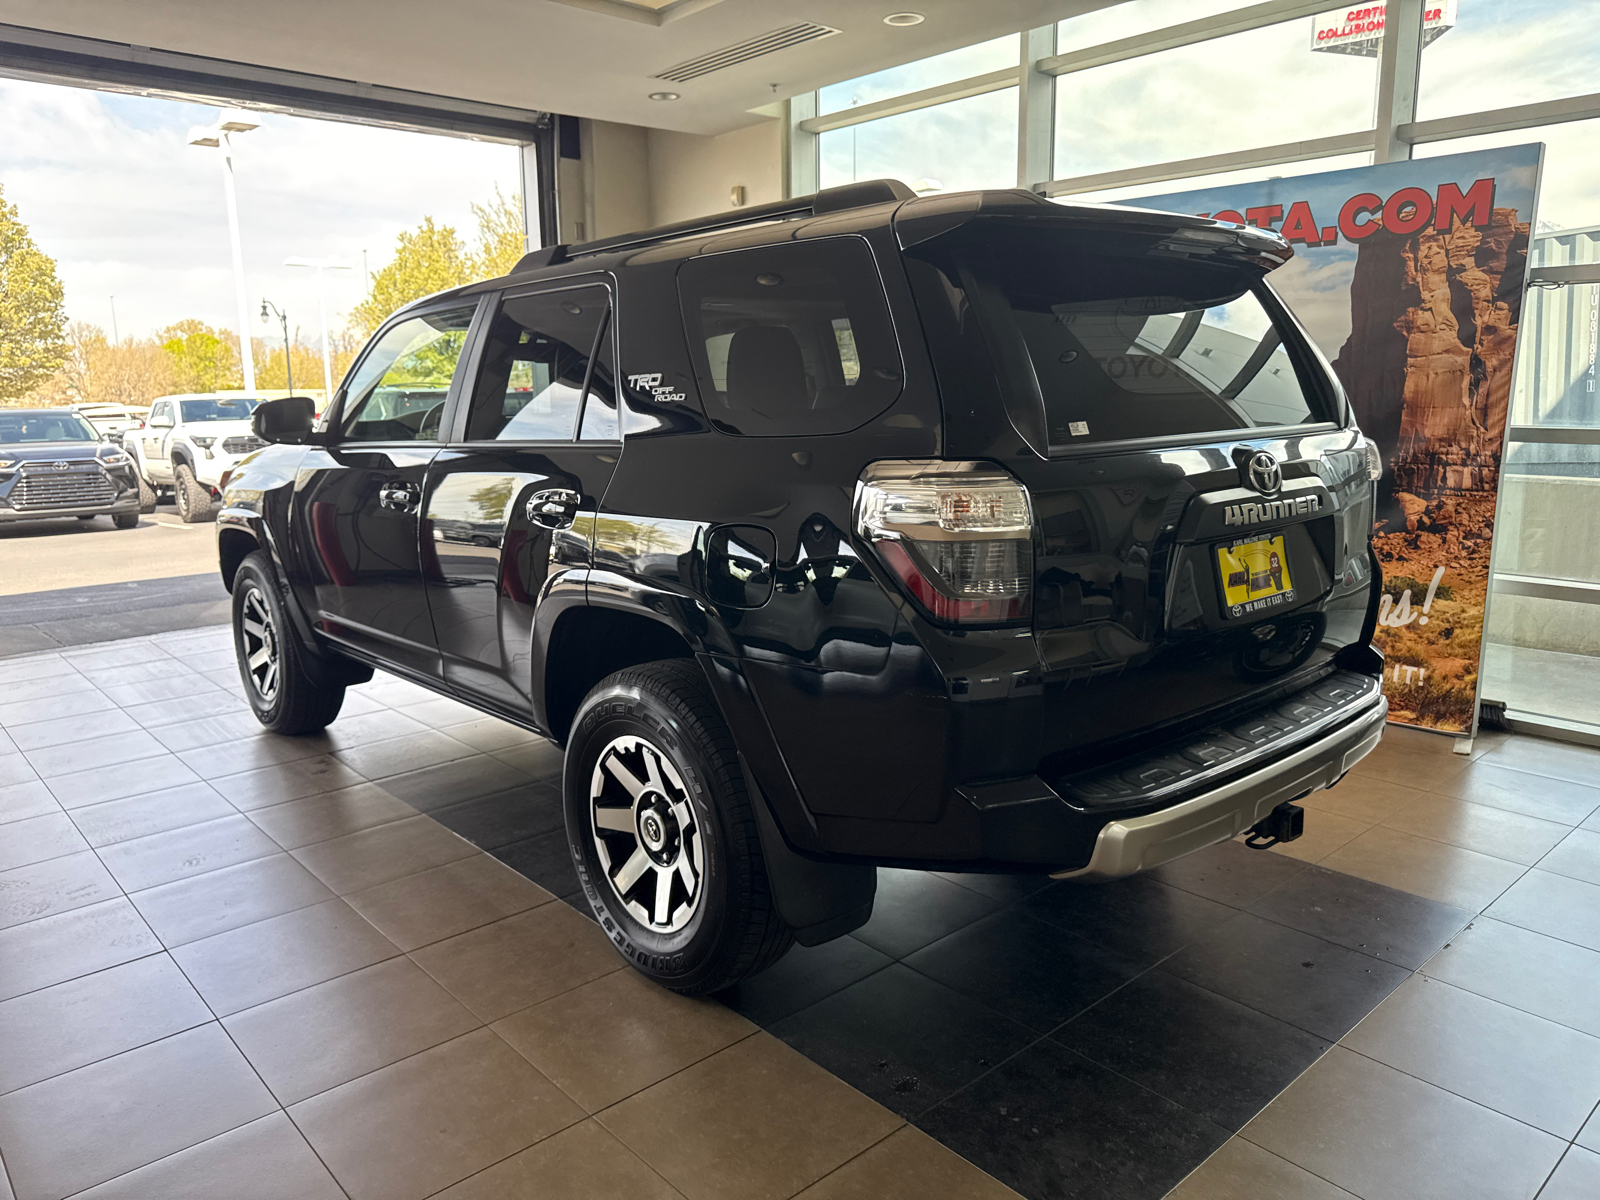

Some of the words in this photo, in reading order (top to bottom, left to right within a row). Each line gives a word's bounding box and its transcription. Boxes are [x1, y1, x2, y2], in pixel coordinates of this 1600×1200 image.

[1317, 19, 1385, 41] COLLISION
[1424, 8, 1442, 22] ER
[1197, 178, 1496, 248] TA.COM
[628, 373, 663, 391] TRD
[651, 386, 675, 395] OFF
[654, 393, 687, 402] ROAD
[1271, 556, 1279, 568] 32
[1245, 602, 1254, 613] WE
[1253, 598, 1267, 611] MAKE
[1266, 597, 1272, 607] IT
[1271, 594, 1283, 605] EASY
[1393, 664, 1426, 687] IT!
[572, 844, 685, 974] BRIDGESTONE
